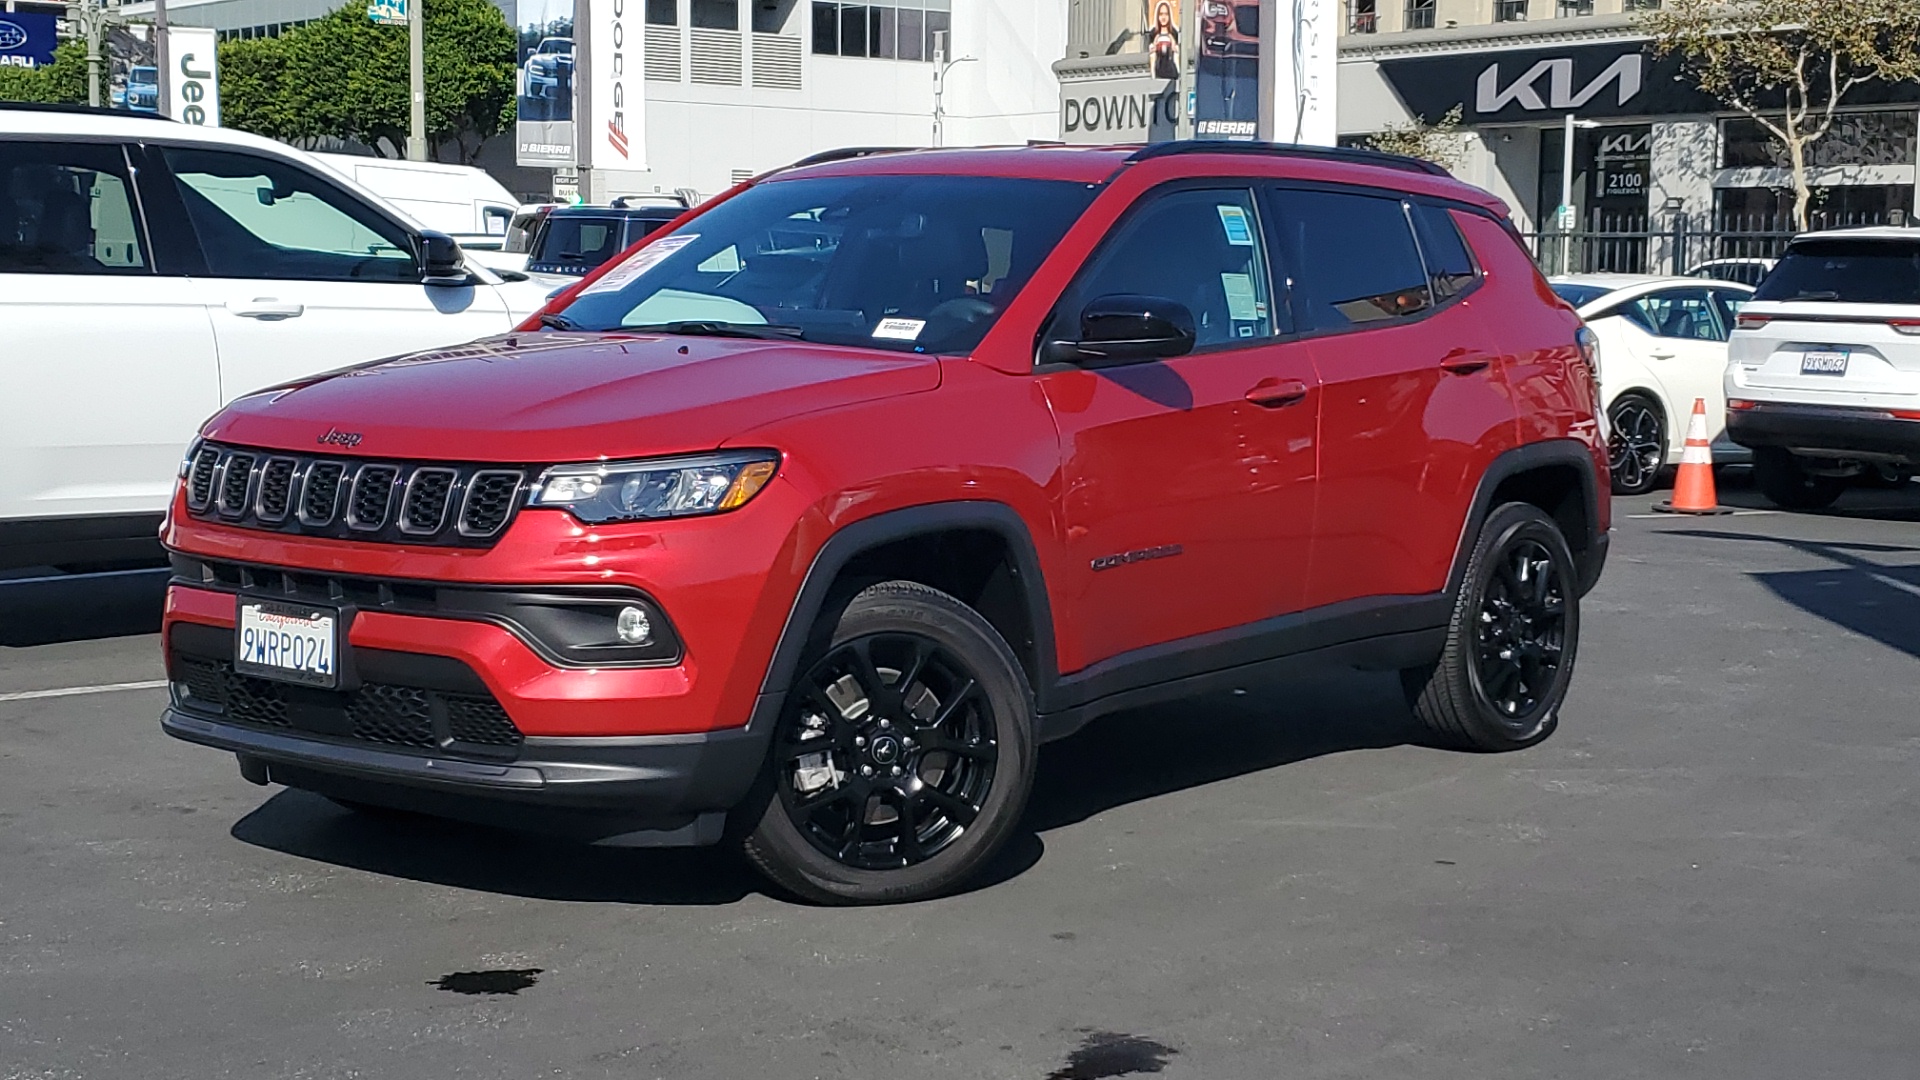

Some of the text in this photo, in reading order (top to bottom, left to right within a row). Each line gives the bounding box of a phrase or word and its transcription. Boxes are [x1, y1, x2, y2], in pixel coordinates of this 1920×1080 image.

[0, 55, 34, 68] ARU
[181, 53, 212, 126] Jee
[1476, 54, 1642, 113] KIA
[1065, 92, 1180, 132] DOWNTO
[1207, 121, 1256, 134] SIERRA
[529, 143, 571, 154] SIERRA
[1601, 133, 1650, 152] KIA
[1609, 173, 1642, 187] 2100
[317, 427, 363, 449] Jeep
[244, 627, 330, 674] 9WRP024
